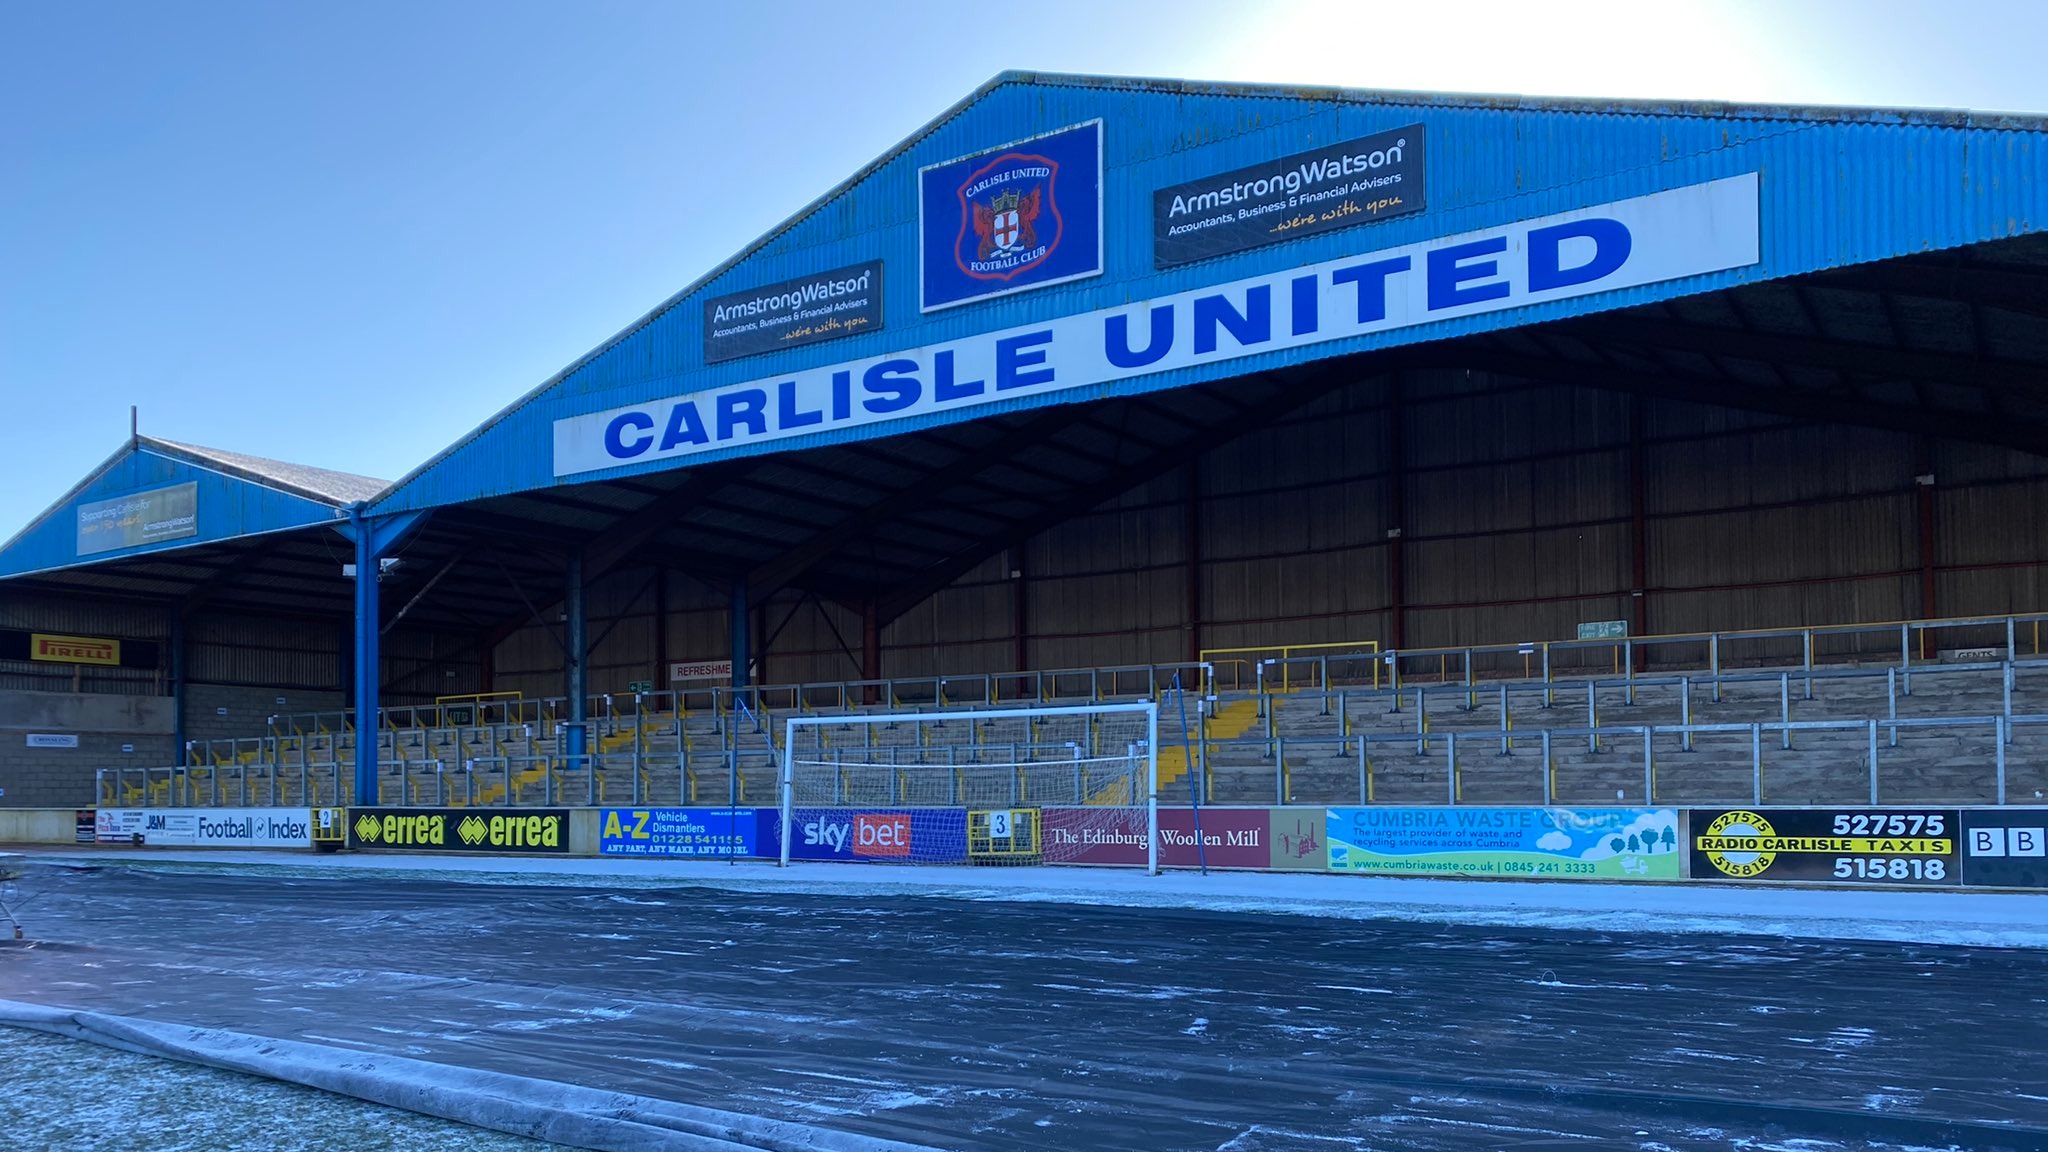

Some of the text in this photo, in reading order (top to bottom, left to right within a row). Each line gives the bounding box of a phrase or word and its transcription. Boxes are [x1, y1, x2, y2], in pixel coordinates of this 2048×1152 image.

[965, 167, 1050, 198] CARLISLE UNITED
[1168, 173, 1402, 236] Accountants, Business & Financial Advisers
[1322, 200, 1361, 220] with
[1366, 196, 1402, 214] you
[970, 257, 1019, 272] FOOTBALL
[1021, 245, 1046, 264] CLUB
[712, 297, 868, 338] Accountants, Business & Financial Advisers
[814, 316, 841, 333] with
[844, 315, 868, 331] you
[604, 217, 1632, 459] CARLISLE UNITED
[40, 640, 112, 659] PIRELLI
[1958, 650, 1993, 659] GENTS
[677, 663, 731, 677] REFRESHME
[146, 815, 166, 830] J&M
[323, 810, 329, 825] 2
[603, 811, 650, 839] A-Z
[655, 811, 688, 822] Vehicle
[996, 814, 1005, 834] 3
[1353, 811, 1622, 828] CUMBRIA WASTE GROUP
[1712, 812, 1770, 832] 527575
[1832, 815, 1945, 836] 527575
[198, 817, 307, 839] Football Index
[652, 822, 706, 833] Dismantlers
[804, 816, 905, 852] sky bet
[1353, 828, 1522, 839] The largest provider of waste and
[652, 835, 693, 844] 01228
[1052, 828, 1259, 850] The Edinburg Woollen Mill
[1353, 838, 1396, 849] recycling
[1399, 838, 1438, 847] services
[1475, 839, 1520, 848] Cumbria
[1702, 838, 1944, 852] RADIO CARLISLE TAXIS
[606, 844, 624, 852] ANY
[625, 844, 647, 854] PART,
[648, 845, 667, 853] ANY
[668, 845, 696, 855] MAKE,
[697, 846, 716, 854] ANY
[1353, 860, 1493, 872] www.cumbriawaste.co.uk
[1504, 862, 1534, 872] 0845
[1538, 862, 1559, 872] 241
[1565, 863, 1596, 873] 3333
[1713, 856, 1769, 875] 515818
[1833, 857, 1946, 880] 515818
